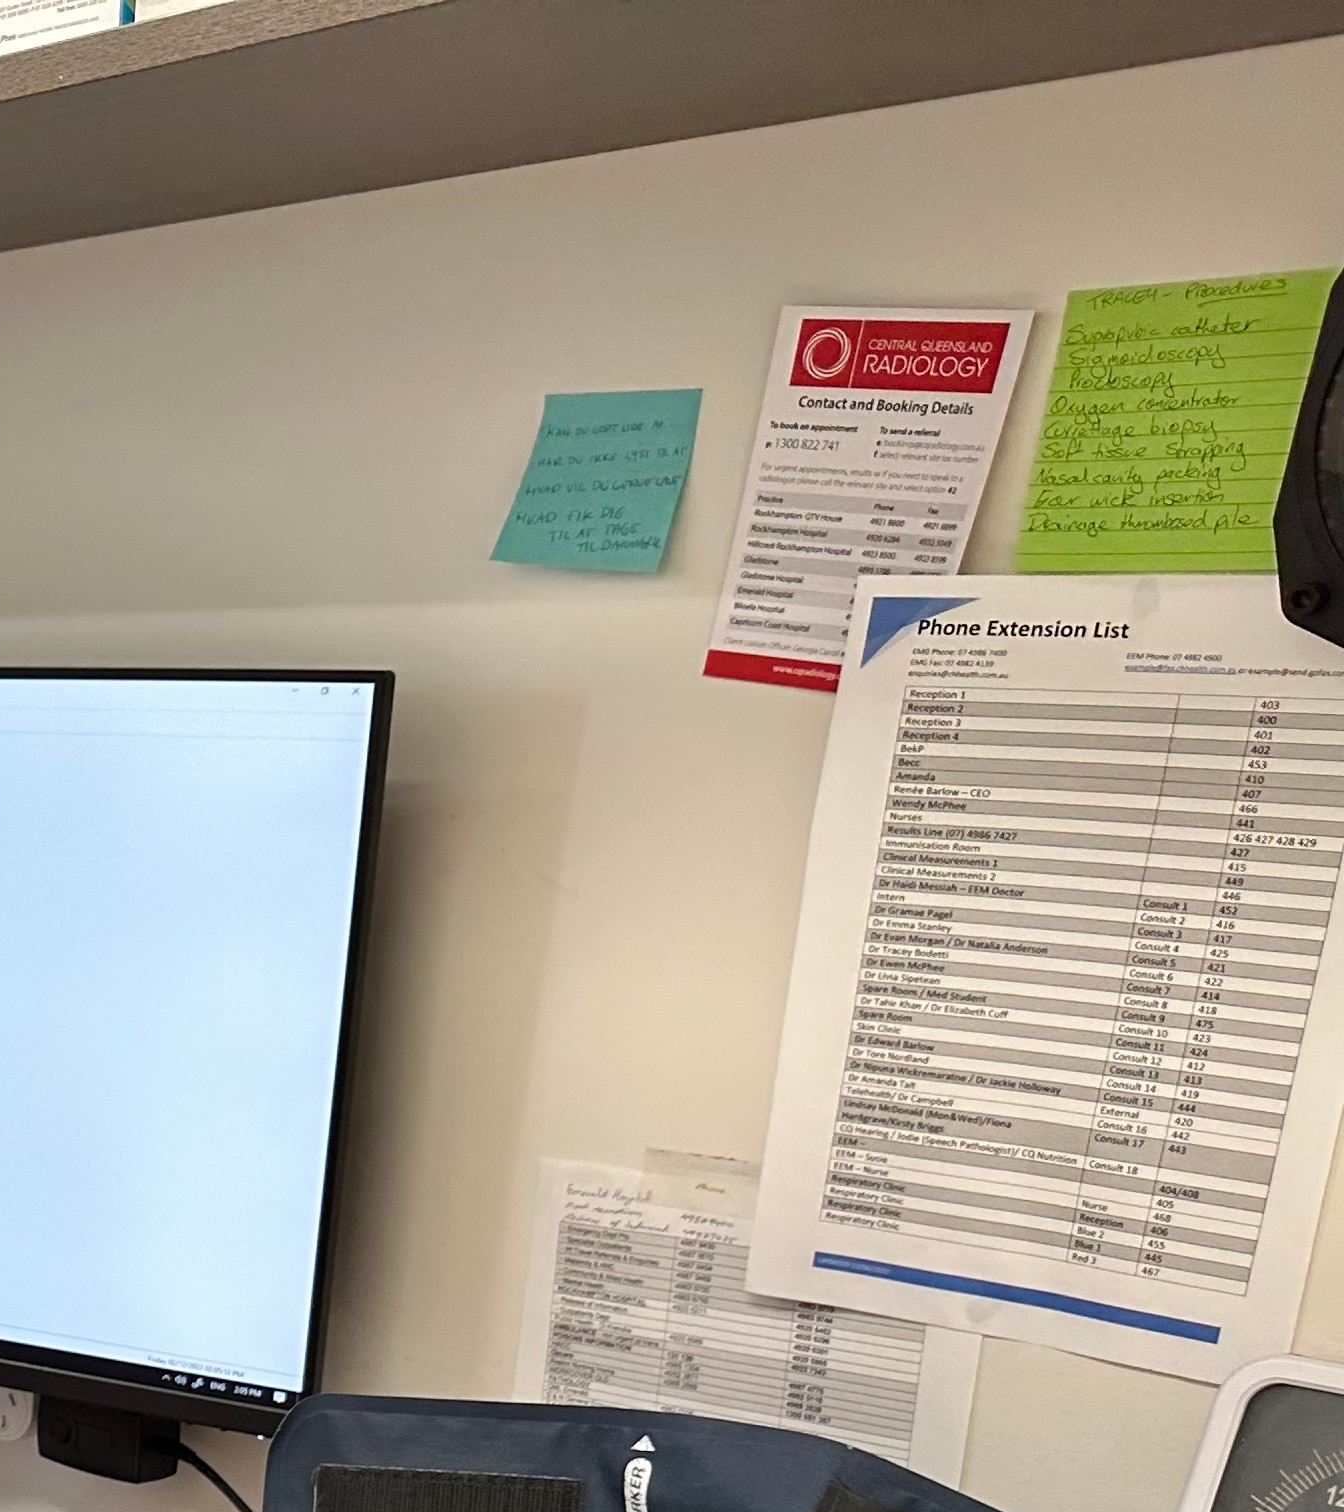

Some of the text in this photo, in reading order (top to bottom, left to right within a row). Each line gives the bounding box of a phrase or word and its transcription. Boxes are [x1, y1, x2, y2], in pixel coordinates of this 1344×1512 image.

[1171, 317, 1260, 335] catheter
[868, 339, 993, 353] CENTRAL QUEENSLAND
[862, 355, 989, 377] RADIOLOGY
[1068, 344, 1225, 378] Sigmoidoscopy
[799, 396, 973, 415] Contact and Booking Details
[1050, 396, 1124, 426] Oxygen
[780, 422, 859, 434] book appointment
[914, 429, 941, 437] referral
[1150, 418, 1216, 443] biopsy
[775, 438, 800, 449] 1300
[802, 439, 821, 450] 822
[1040, 440, 1083, 460] Soft
[1093, 441, 1146, 459] tissue
[1034, 465, 1221, 494] Nasal cavity packing
[1090, 492, 1135, 508] wick
[1149, 489, 1225, 507] insertion
[1028, 513, 1109, 537] Drainage
[1213, 507, 1260, 536] pile
[917, 619, 1130, 639] Phone Extension List
[911, 690, 958, 700] Reception
[908, 703, 957, 714] Reception
[1260, 700, 1279, 710] 403
[905, 718, 953, 728] Reception
[1257, 716, 1277, 725] 400
[903, 731, 959, 742] Reception 4
[1254, 730, 1272, 740] 401
[1250, 745, 1270, 755] 402
[1248, 760, 1267, 770] 453
[1245, 775, 1264, 784] 410
[926, 786, 991, 798] Barlow CEO
[1242, 789, 1261, 799] 407
[892, 799, 966, 811] Wendy McPhee
[1239, 804, 1258, 814] 466
[890, 813, 922, 822] Nurses
[887, 826, 1017, 841] Results Line (07) 4986 7427
[885, 840, 981, 852] Immunisation Room
[883, 853, 990, 867] Clinical Measurements
[1228, 863, 1246, 872] 415
[1213, 935, 1232, 944] 417
[1071, 1253, 1089, 1263] Red
[249, 1388, 261, 1397] PM
